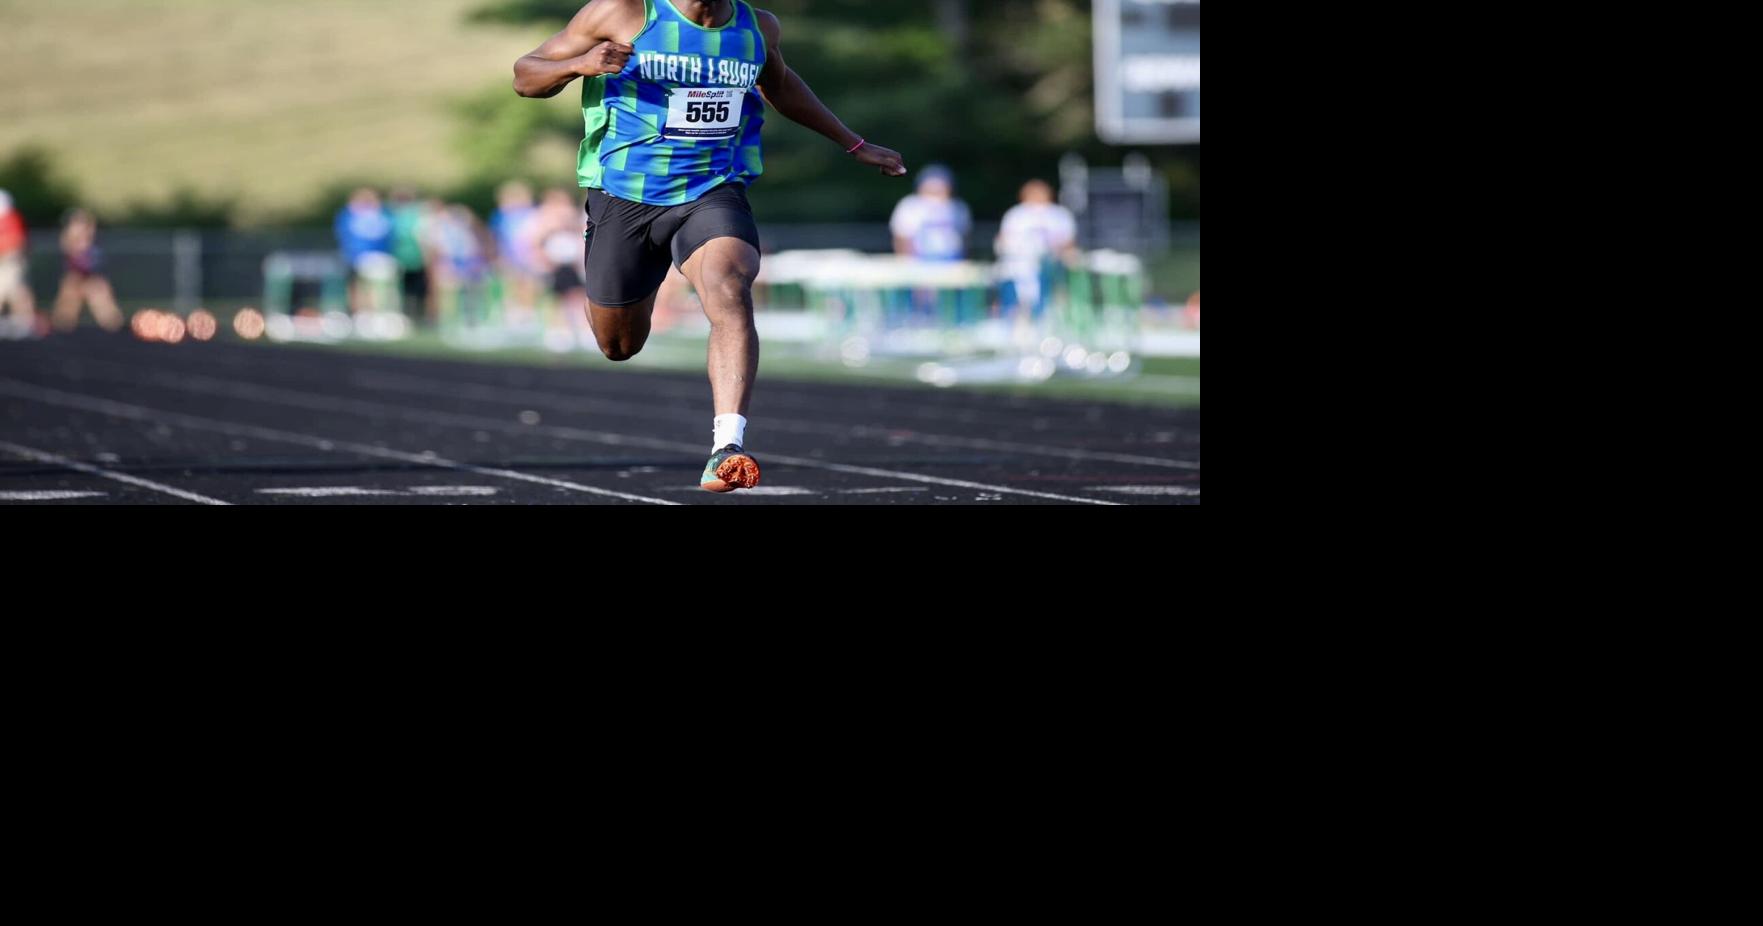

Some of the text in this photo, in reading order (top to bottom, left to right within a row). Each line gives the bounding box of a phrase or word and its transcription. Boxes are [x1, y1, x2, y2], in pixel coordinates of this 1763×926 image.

[639, 53, 701, 83] NORTH
[687, 90, 725, 99] MileSplit
[686, 101, 730, 123] 555
